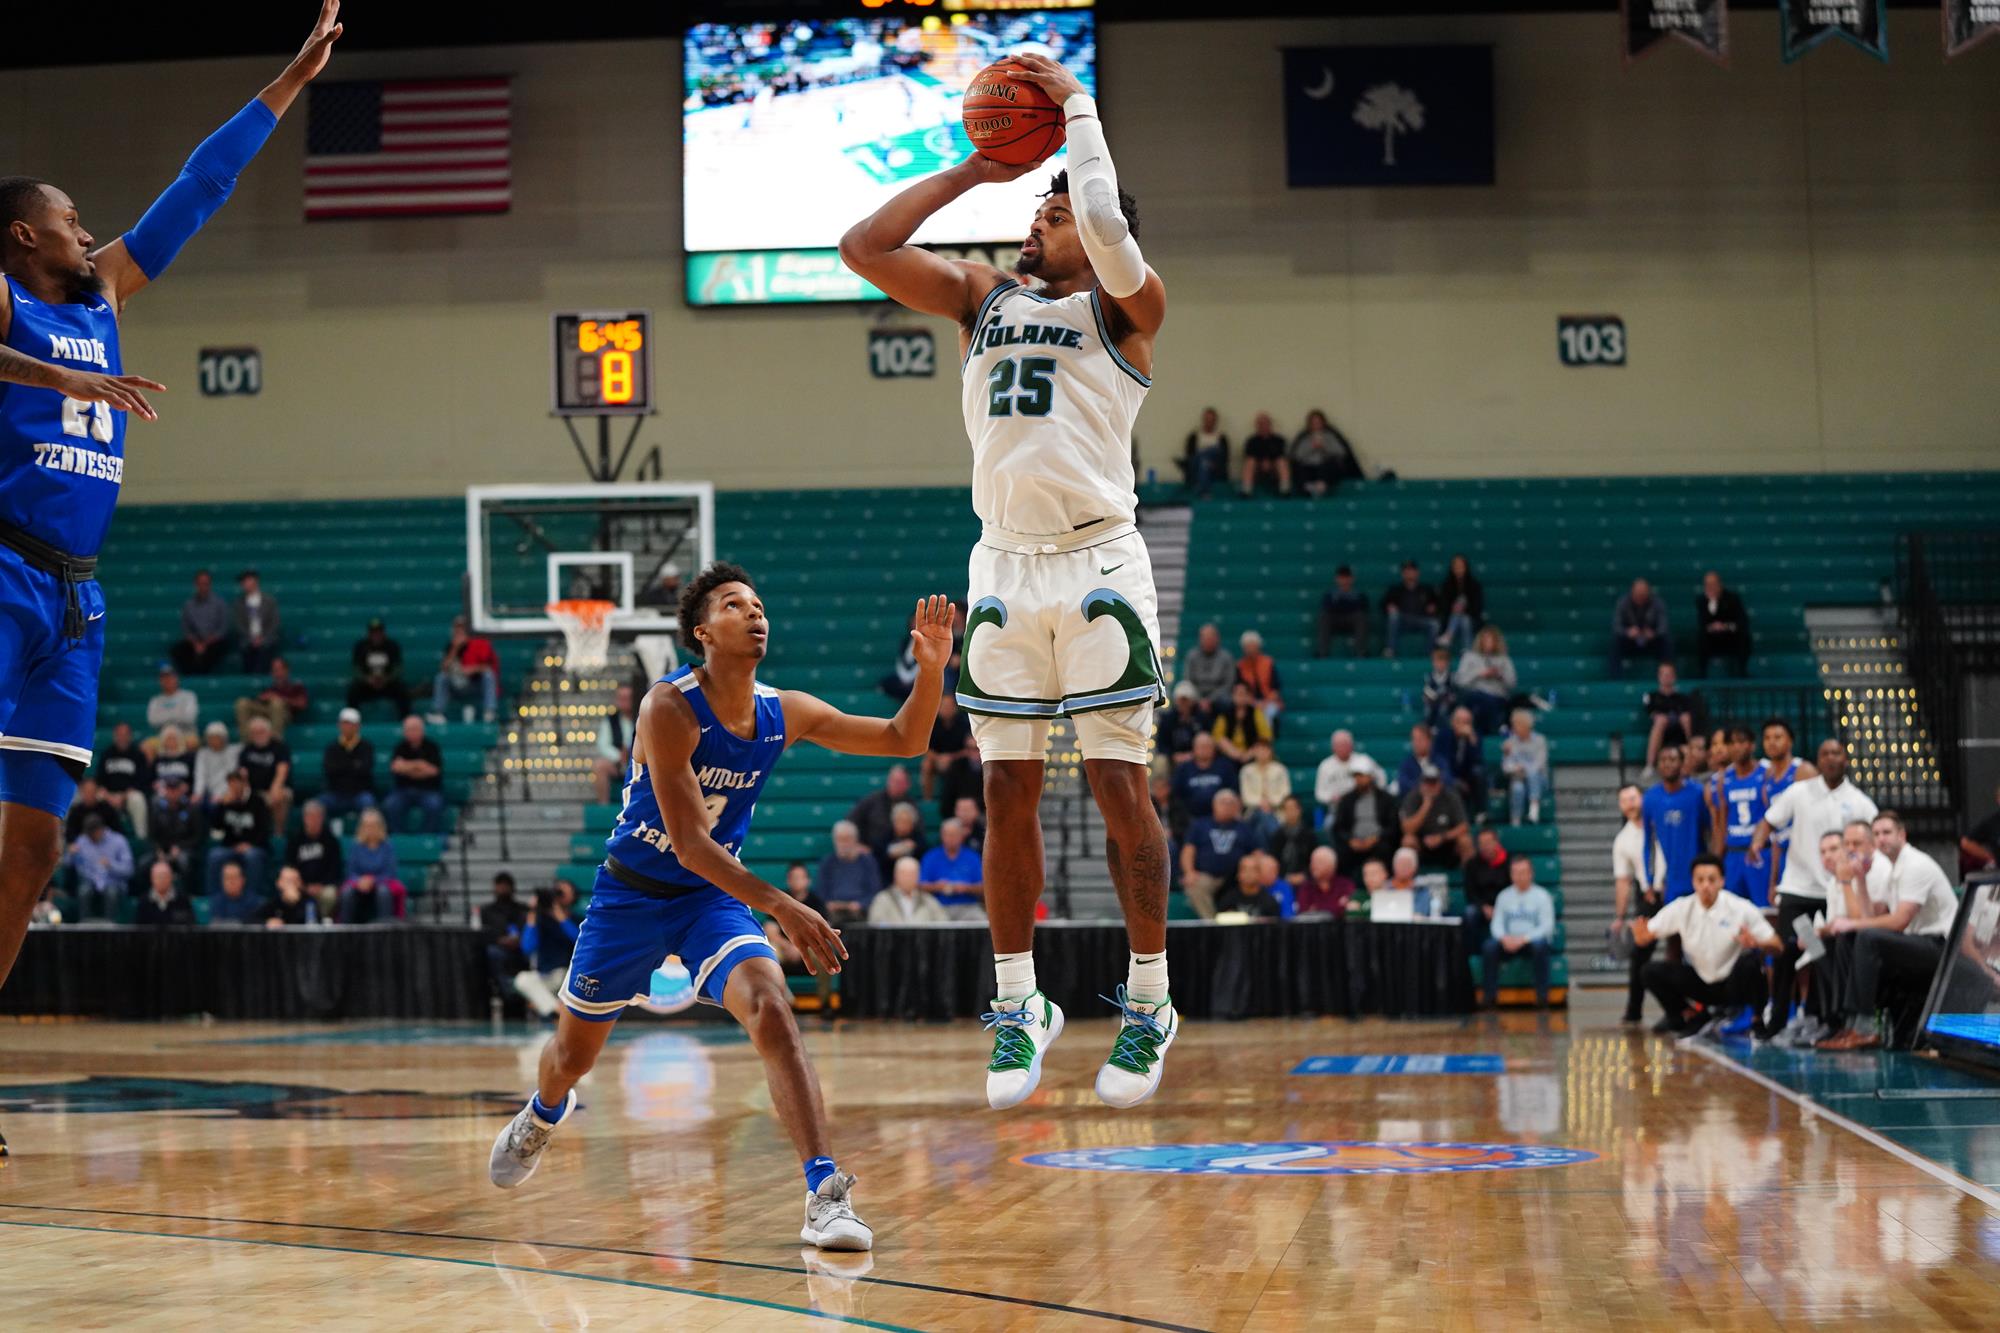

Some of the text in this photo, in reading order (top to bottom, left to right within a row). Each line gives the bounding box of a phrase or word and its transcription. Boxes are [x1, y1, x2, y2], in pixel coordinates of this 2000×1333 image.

[578, 320, 642, 352] 6:45
[973, 314, 1082, 356] TULANE
[1561, 325, 1622, 361] 103
[200, 355, 259, 391] 101
[872, 337, 932, 373] 102
[601, 349, 633, 403] 8
[986, 356, 1057, 418] 25
[33, 443, 124, 484] TENNESSE
